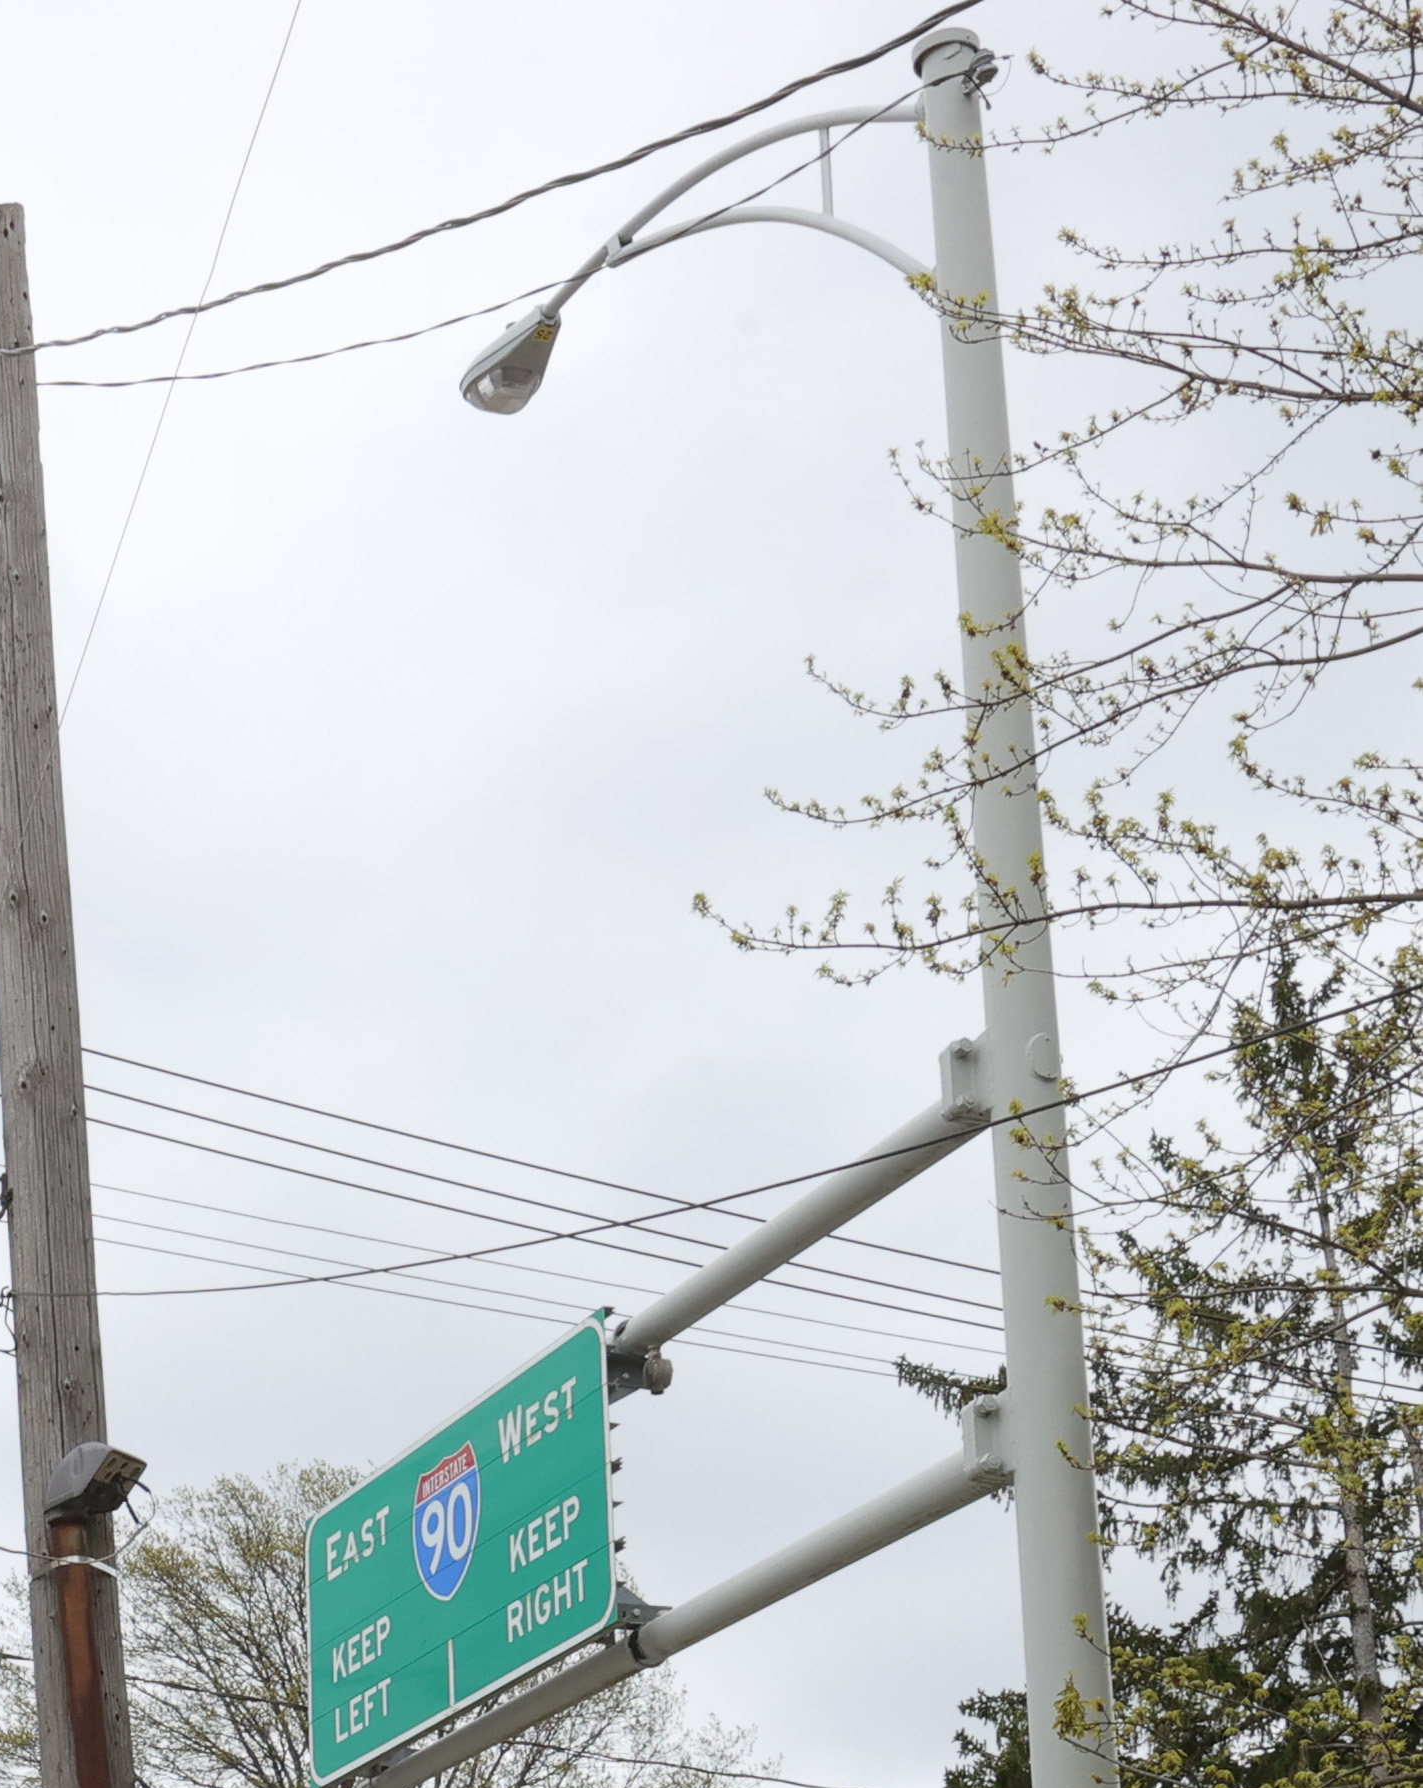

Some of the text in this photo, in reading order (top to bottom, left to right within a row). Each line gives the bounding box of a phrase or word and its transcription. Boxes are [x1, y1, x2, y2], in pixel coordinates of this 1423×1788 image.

[497, 1376, 578, 1464] WEST
[422, 1452, 469, 1499] INTERSTATE
[326, 1505, 391, 1582] EAST
[421, 1481, 473, 1576] 90
[508, 1495, 581, 1574] KEEP
[506, 1558, 589, 1643] RIGHT
[332, 1615, 392, 1684] KEEP
[335, 1677, 392, 1744] LEFT
